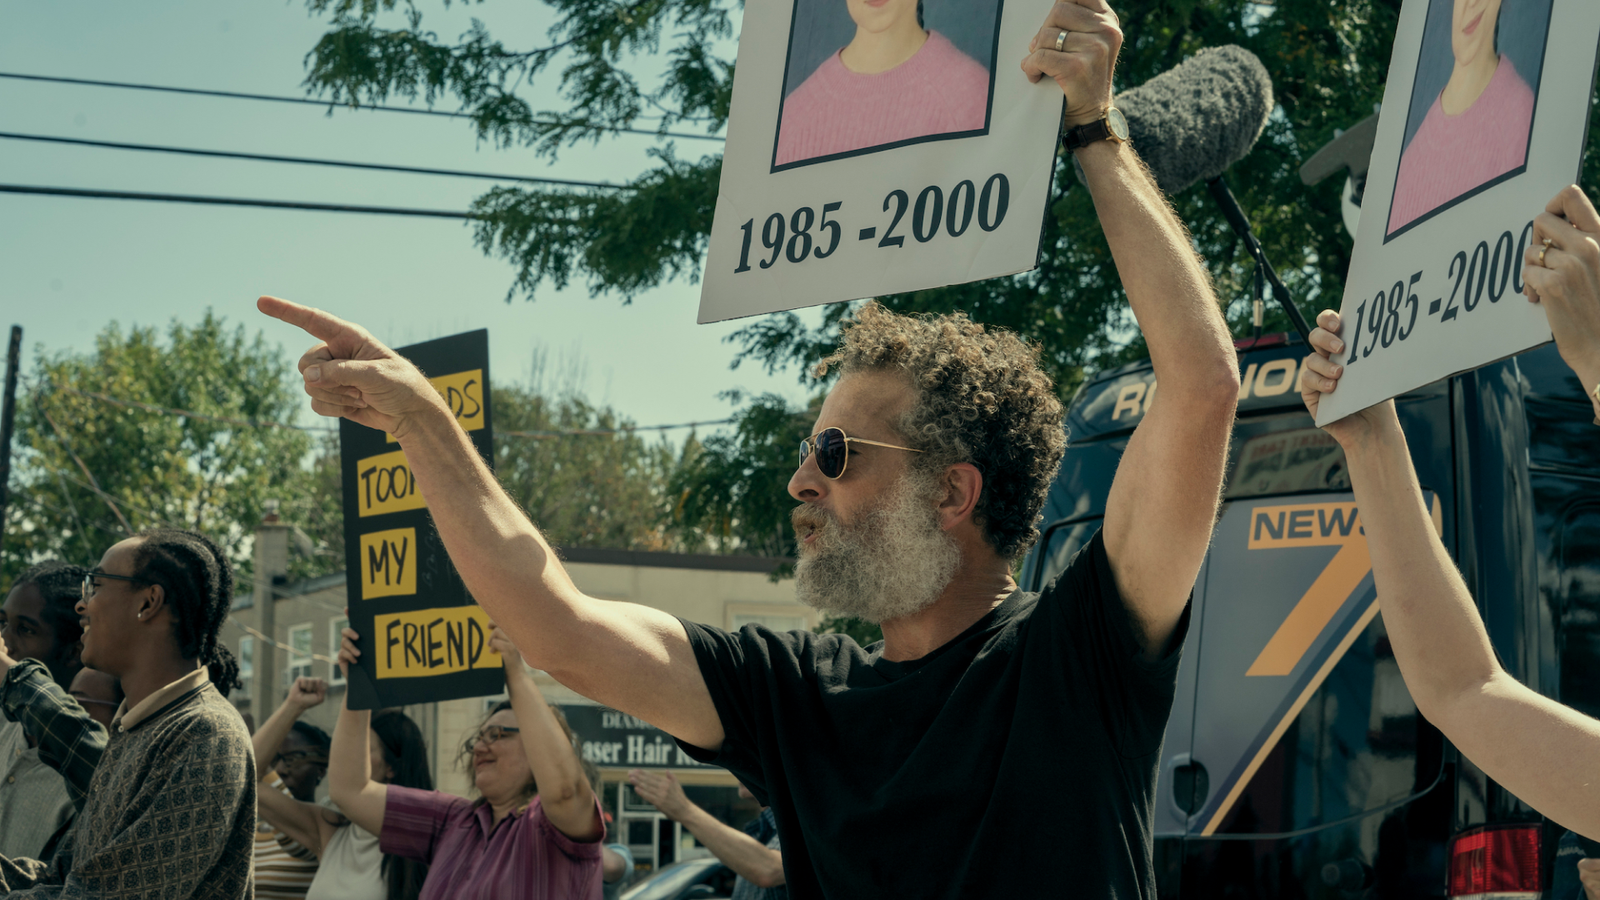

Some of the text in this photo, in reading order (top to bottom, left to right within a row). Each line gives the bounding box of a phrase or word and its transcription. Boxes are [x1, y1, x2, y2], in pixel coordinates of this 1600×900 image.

[734, 201, 843, 274] 1985
[1346, 270, 1423, 365] 1985
[1254, 507, 1366, 541] NEW
[368, 536, 408, 586] MY
[386, 617, 484, 670] FRIEND
[572, 733, 623, 764] aser
[626, 734, 673, 765] Hair
